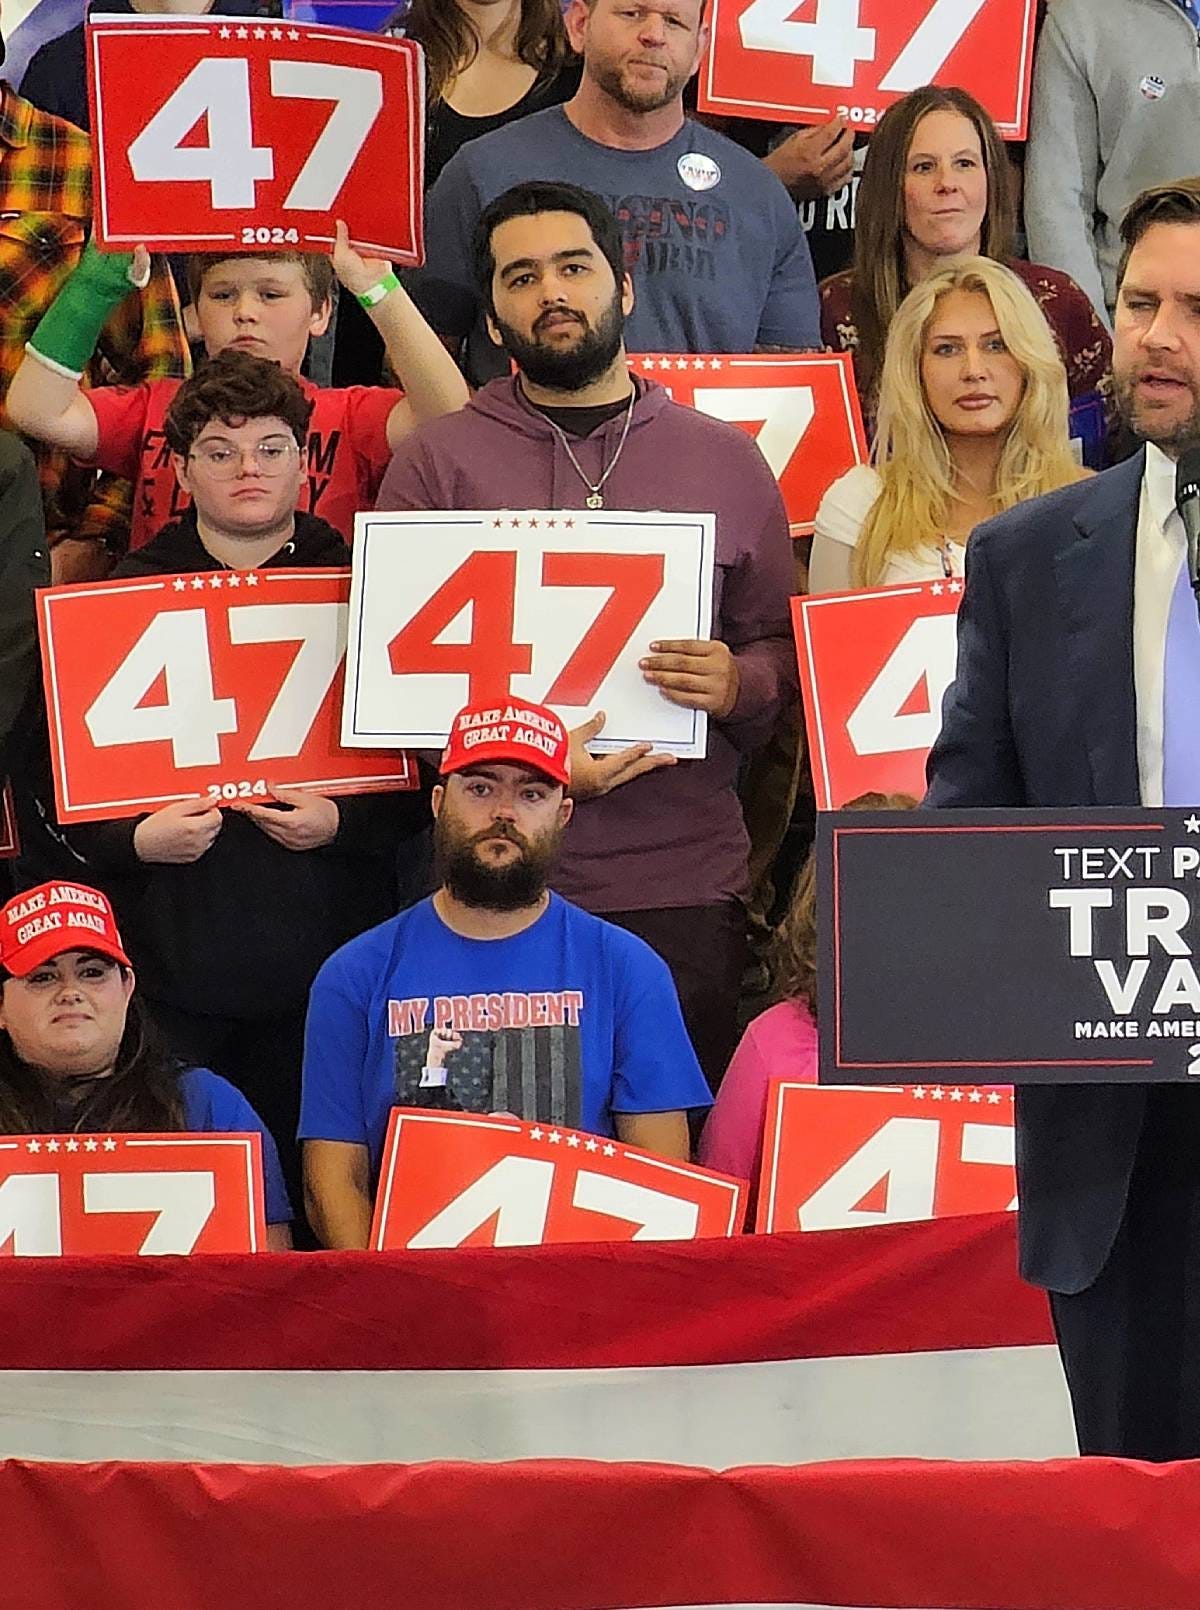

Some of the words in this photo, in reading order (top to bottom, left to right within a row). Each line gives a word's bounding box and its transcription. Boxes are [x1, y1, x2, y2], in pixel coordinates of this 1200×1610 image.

[836, 105, 886, 123] 202
[127, 57, 383, 211] 47
[242, 227, 299, 244] 2024
[666, 386, 815, 481] 7
[387, 550, 666, 707] 47
[84, 602, 349, 769] 47
[846, 613, 958, 756] 4
[459, 709, 501, 731] MAKE
[502, 706, 563, 741] AMERICA
[464, 725, 510, 750] GREAT
[512, 727, 558, 758] AGAIN
[208, 780, 267, 800] 2024
[1054, 847, 1160, 879] TEXT
[7, 893, 46, 925] MAKE
[49, 886, 108, 913] AMERICA
[17, 912, 62, 944] GREAT
[67, 912, 106, 935] AGAIN
[389, 998, 429, 1036] MY
[433, 991, 583, 1031] PRESIDENT
[1075, 1021, 1139, 1038] MAKE
